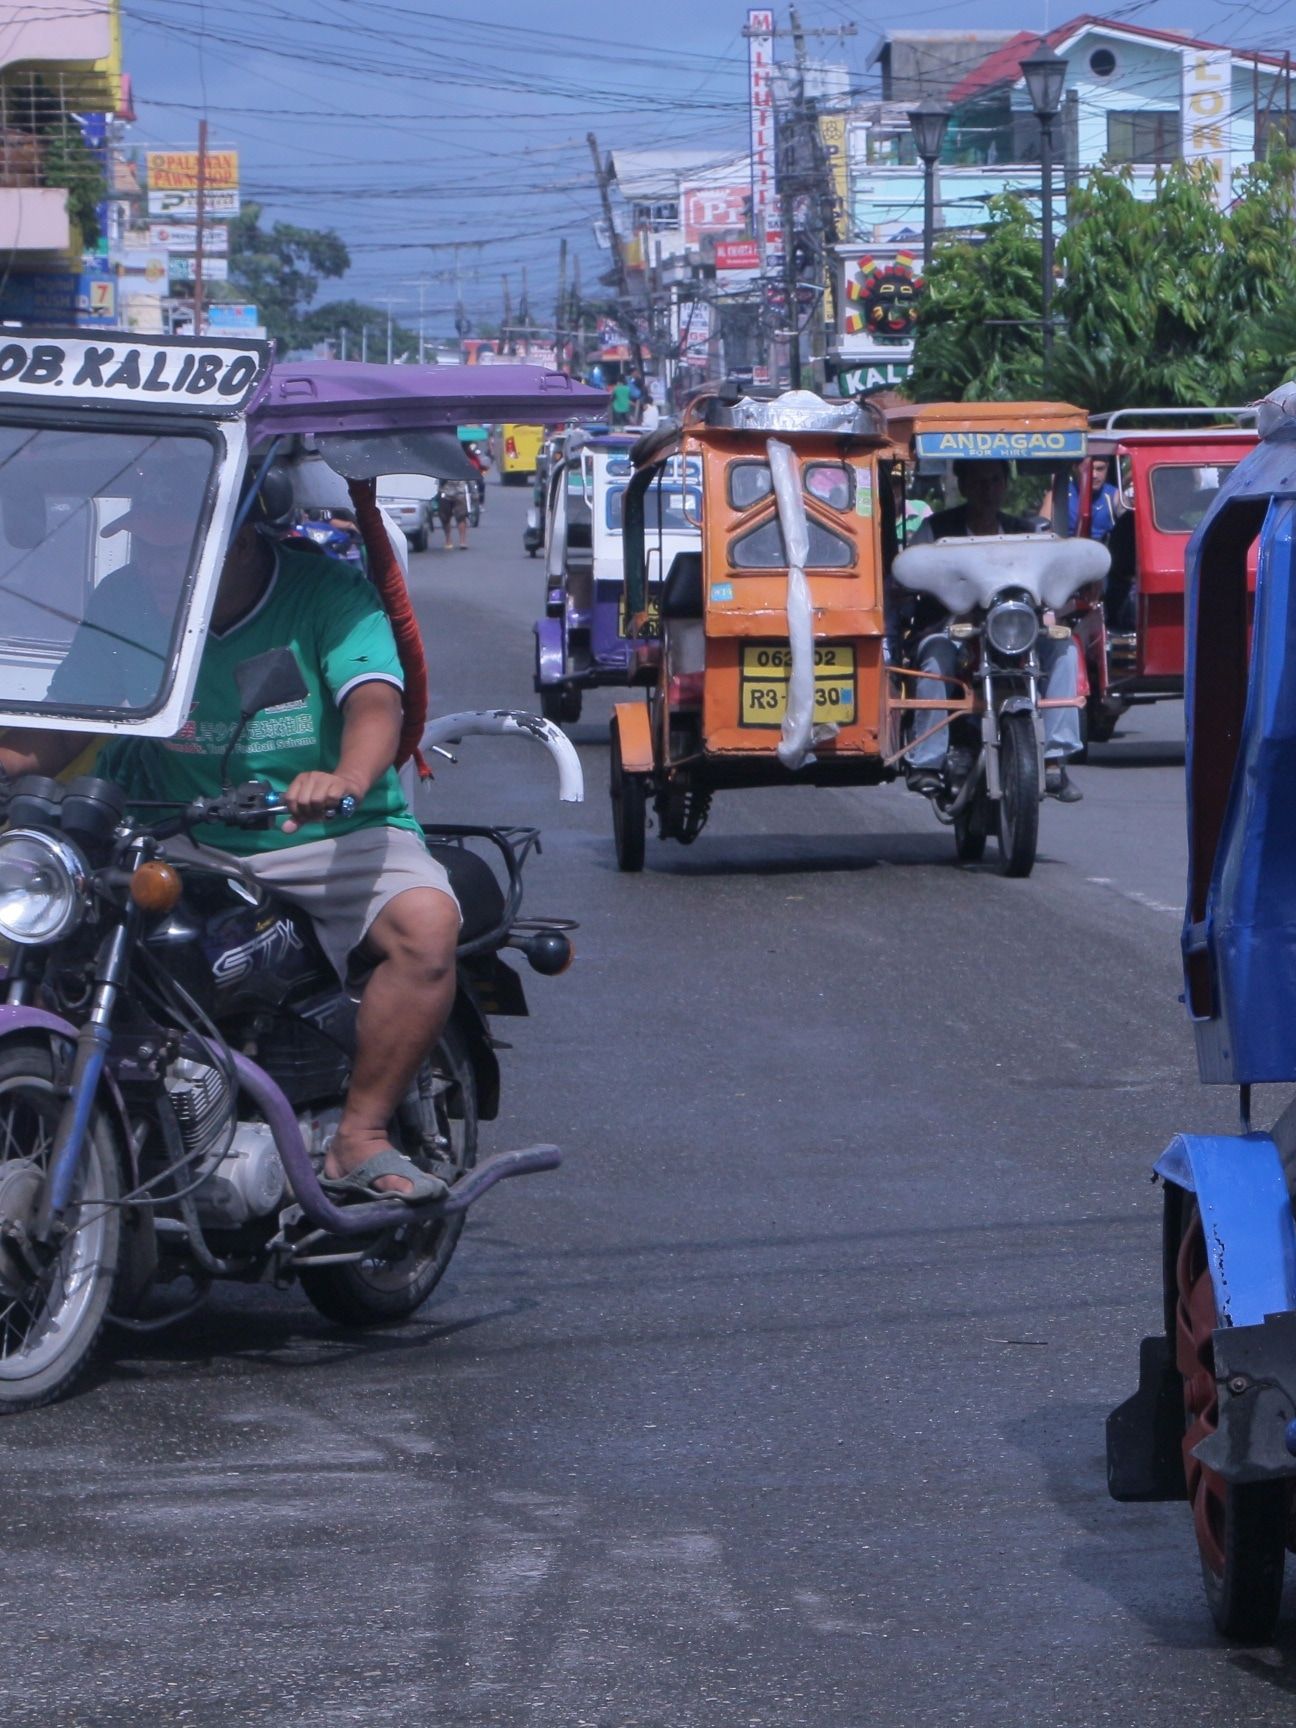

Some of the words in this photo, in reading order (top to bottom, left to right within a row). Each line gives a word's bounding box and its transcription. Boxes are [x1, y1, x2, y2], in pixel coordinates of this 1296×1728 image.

[72, 347, 257, 396] KALIBO
[940, 433, 1065, 449] ANDAGAO
[969, 449, 992, 457] FOR
[1001, 449, 1028, 457] HIRE
[277, 736, 317, 749] Scheme
[212, 918, 304, 989] STX
